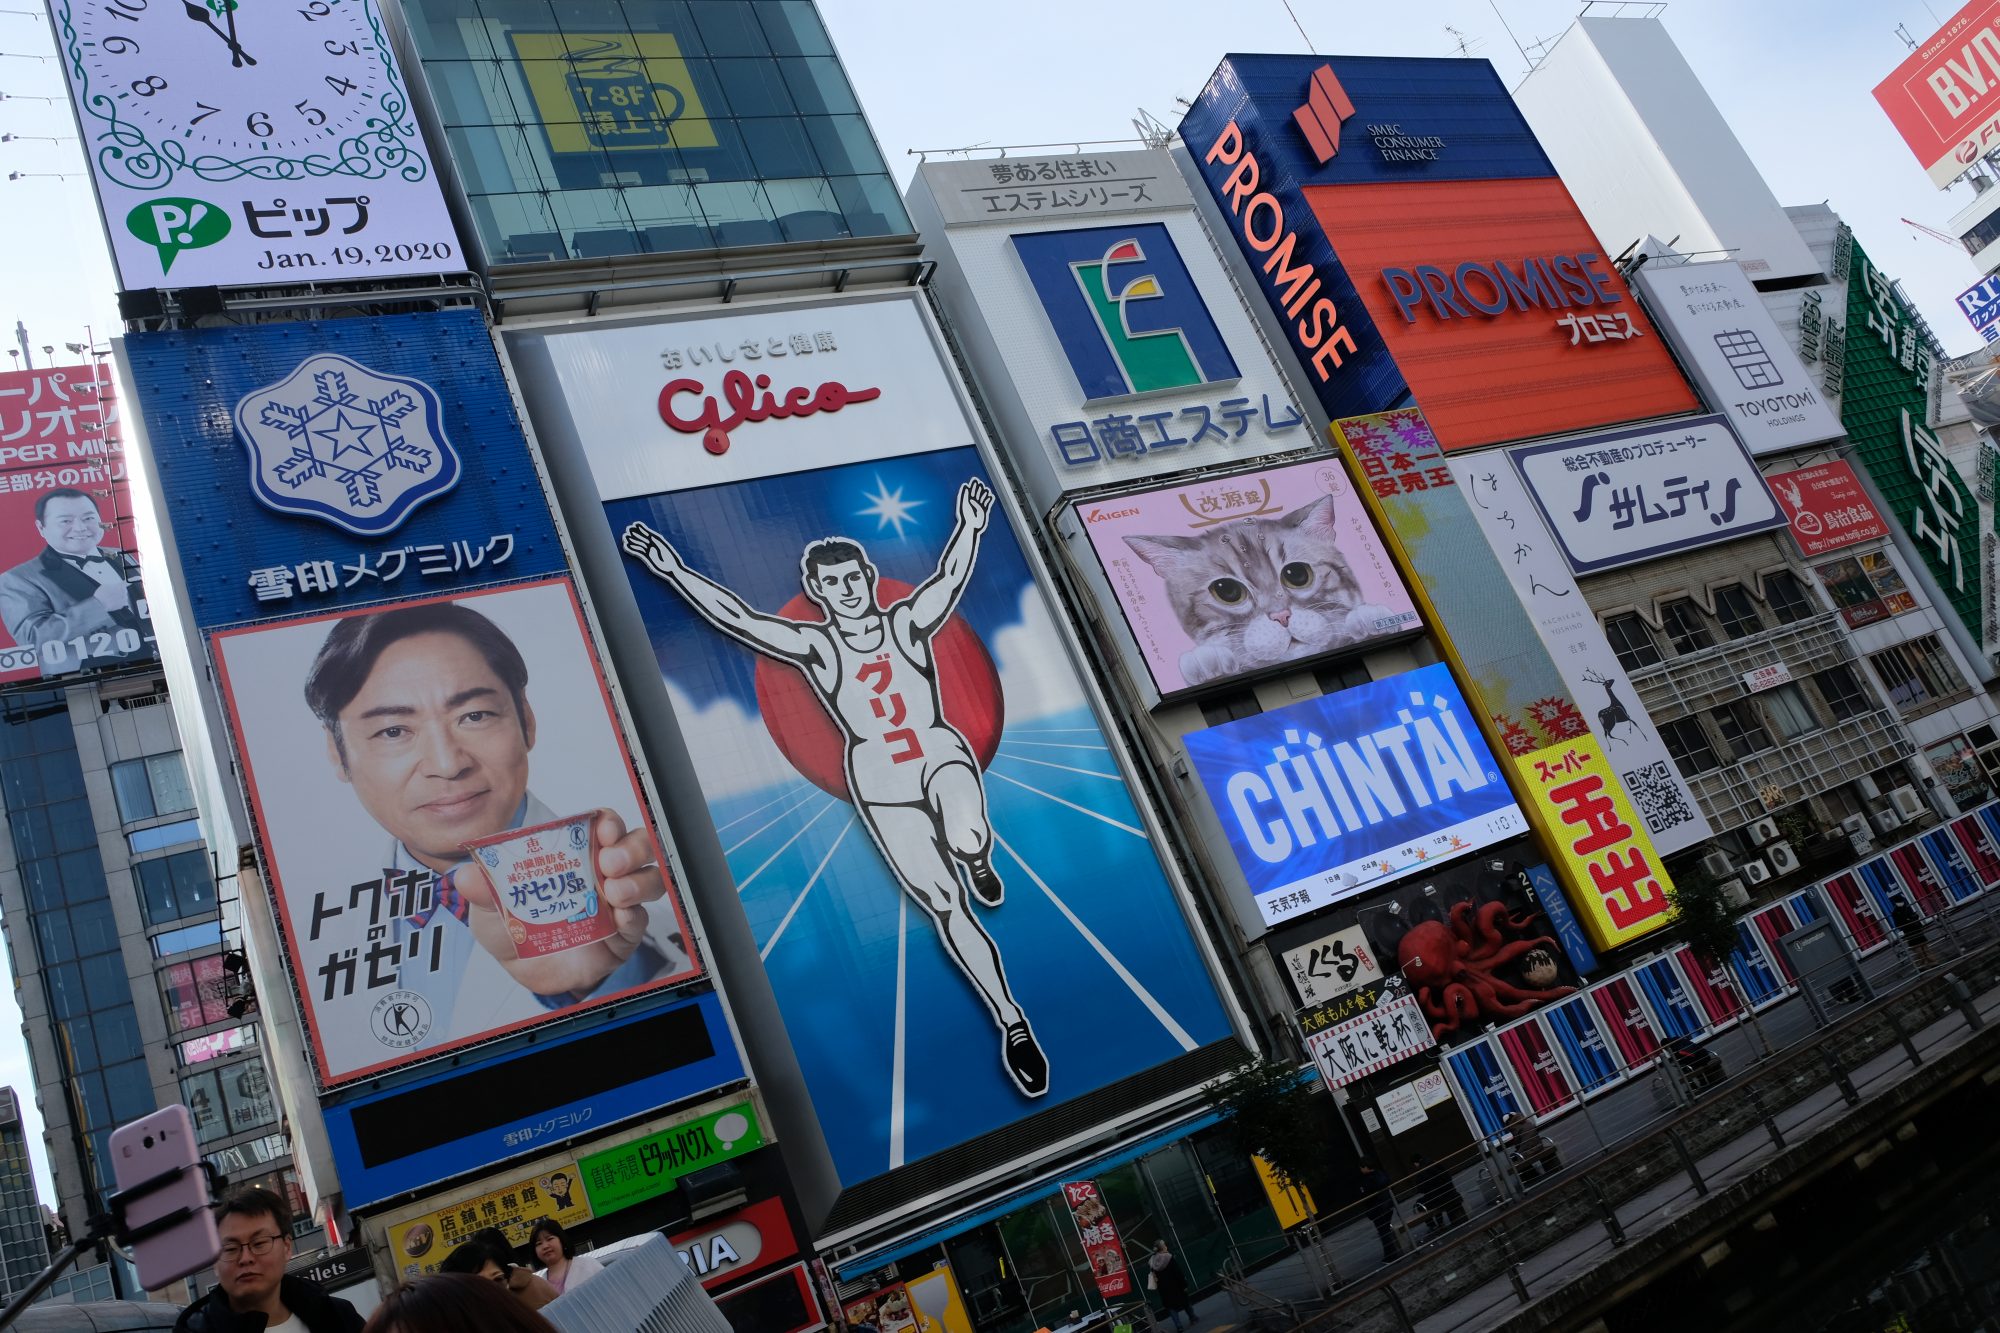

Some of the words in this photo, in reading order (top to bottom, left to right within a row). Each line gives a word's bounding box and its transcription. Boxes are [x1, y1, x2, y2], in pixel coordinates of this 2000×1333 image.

[298, 1, 331, 22] 2
[102, 36, 140, 55] 9
[323, 40, 359, 56] 3
[1922, 38, 1946, 60] Since
[131, 75, 168, 97] 8
[324, 74, 358, 96] 4
[189, 101, 222, 127] 7
[247, 112, 273, 137] 6
[294, 99, 326, 126] 5
[1367, 123, 1404, 136] SMBC
[1374, 135, 1446, 150] CONSUMER
[1381, 148, 1440, 162] FINANCE
[988, 159, 1117, 184] 夢ある住まい
[981, 182, 1153, 214] エステムシリーズ
[242, 195, 371, 239] ピップ
[1205, 121, 1358, 382] PROMISE
[1380, 252, 1628, 324] PROMISE
[1959, 275, 2000, 316] RI
[1556, 311, 1643, 346] プロミス
[1981, 323, 2000, 343] 吉
[660, 330, 838, 370] おいしさと健康
[1050, 393, 1304, 466] 日商エステム
[1766, 414, 1806, 428] HOLDINGS
[1360, 452, 1440, 478] 日本一
[1562, 435, 1707, 472] 総合不動産のプロデューサー
[1321, 470, 1336, 482] 36
[1371, 465, 1455, 499] 安売王
[1086, 507, 1141, 524] KAIGEN
[248, 533, 514, 601] 雪印メグミルク
[855, 652, 924, 764] グリコ
[1226, 690, 1490, 864] CHINTAI
[1534, 749, 1592, 783] スーパー
[524, 837, 543, 854] 恵
[1548, 775, 1669, 930] 玉出
[1518, 871, 1534, 903] 2F
[310, 868, 434, 942] トクホ
[529, 898, 578, 919] ヨーグルト
[1268, 889, 1312, 917] 天気予報
[367, 924, 388, 942] の
[318, 924, 444, 1002] ガセリ
[1308, 940, 1359, 983] くくる
[1302, 989, 1377, 1032] 大阪もんを食す
[1322, 1013, 1413, 1078] 大阪に乾杯
[502, 1107, 593, 1148] 雪印メグミルク
[639, 1126, 714, 1177] ピタットハウス
[1068, 1184, 1097, 1202] たこ
[439, 1187, 538, 1233] 店舗情報館
[1083, 1222, 1115, 1248] 焼き
